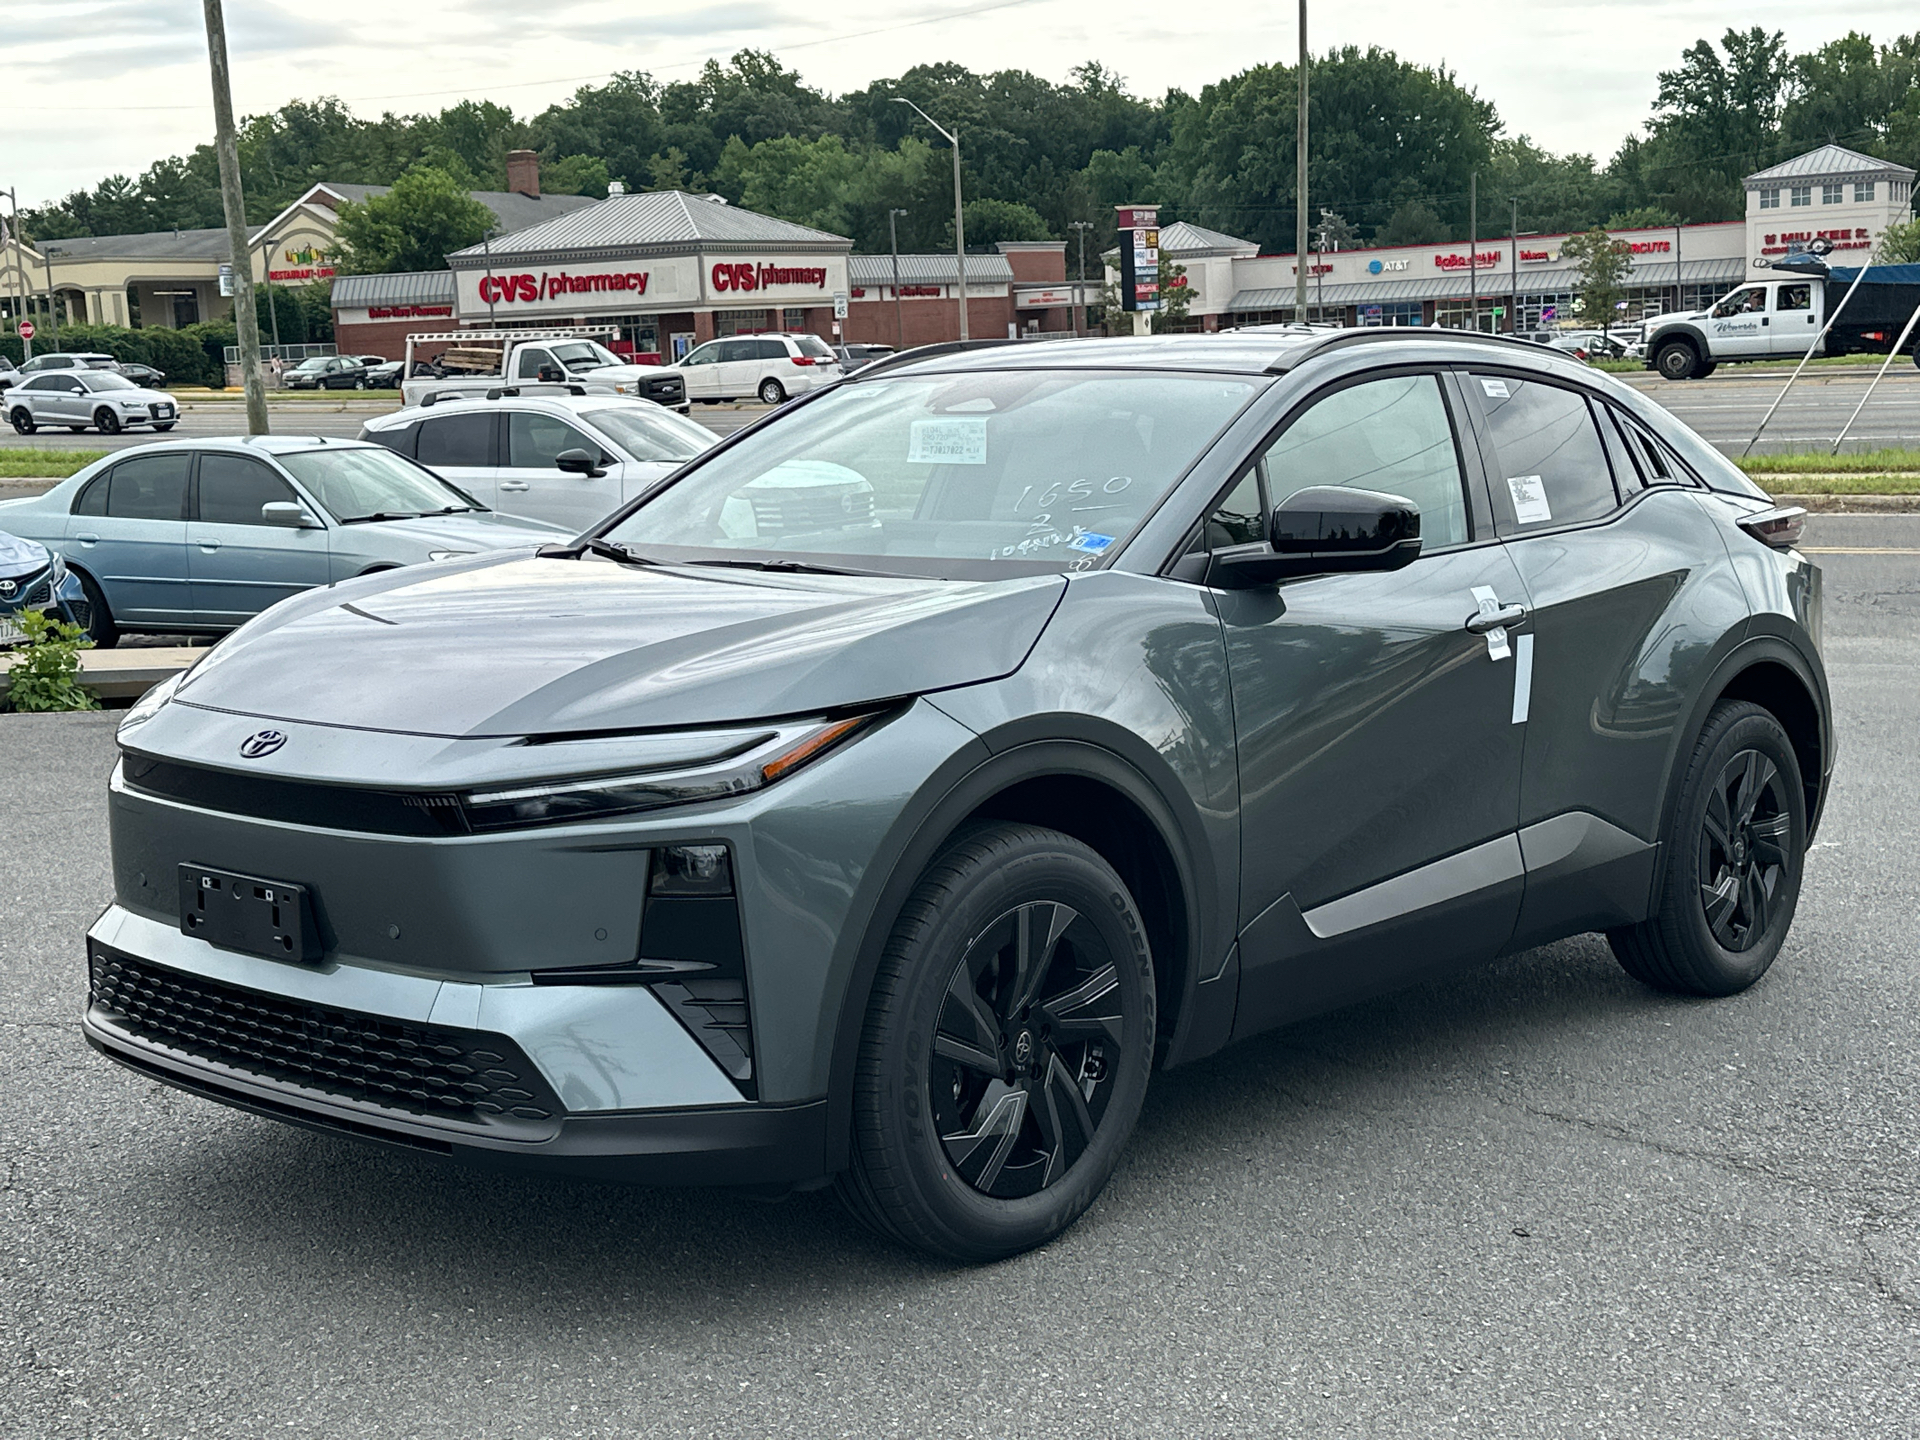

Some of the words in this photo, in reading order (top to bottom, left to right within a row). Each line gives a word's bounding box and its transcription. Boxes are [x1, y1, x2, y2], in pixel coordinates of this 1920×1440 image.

[1817, 229, 1851, 240] KEE
[1383, 260, 1409, 271] AT&T
[837, 305, 846, 316] 45
[1108, 891, 1151, 978] OPEN
[902, 1029, 926, 1147] TOYO
